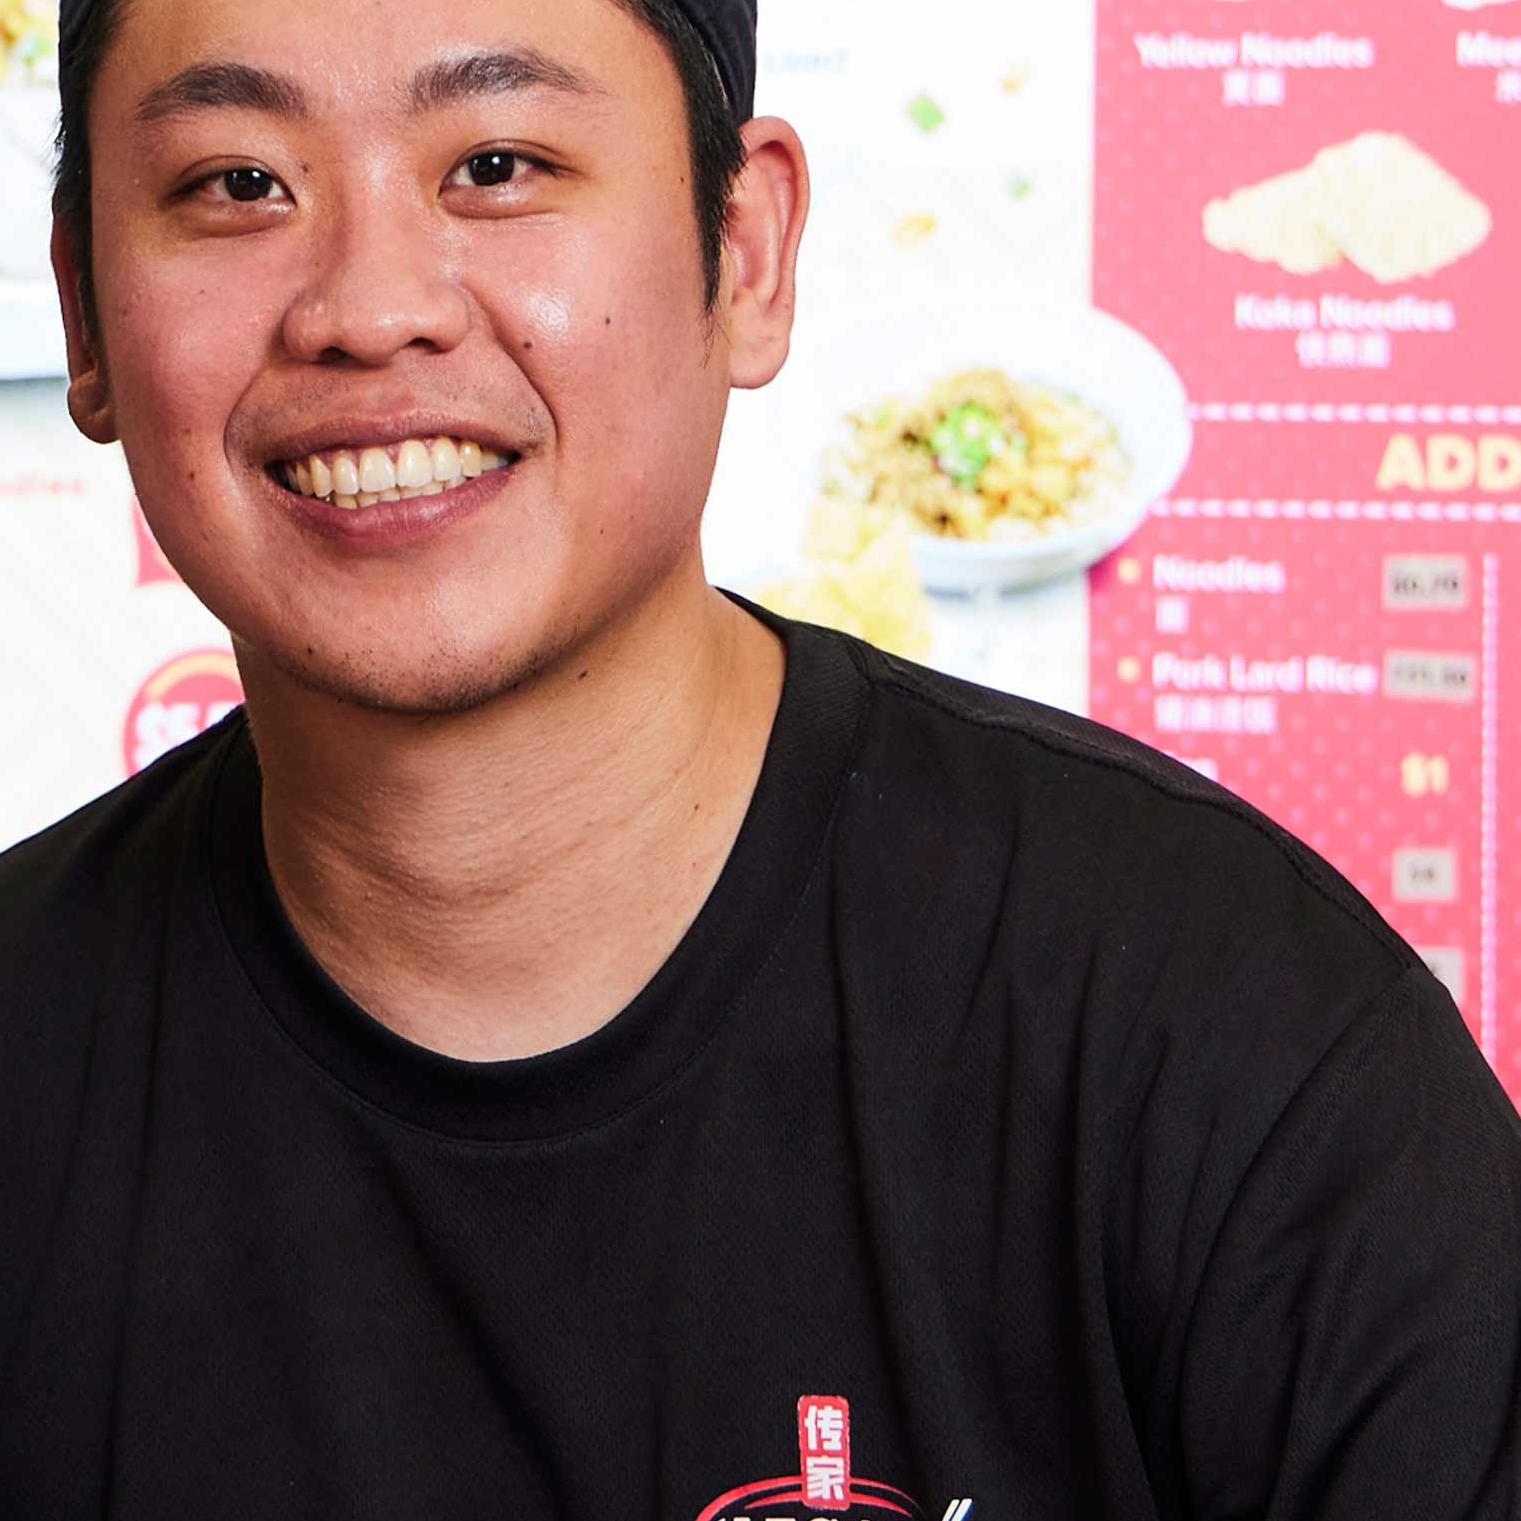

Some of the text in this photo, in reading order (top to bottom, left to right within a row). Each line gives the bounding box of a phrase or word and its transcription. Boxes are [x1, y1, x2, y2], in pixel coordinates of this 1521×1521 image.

[1133, 31, 1376, 70] Yellow Noodles
[1319, 293, 1457, 332] Noodles
[1376, 432, 1521, 493] ADD
[1152, 556, 1287, 594] Noodles
[804, 1404, 846, 1502] 传家
